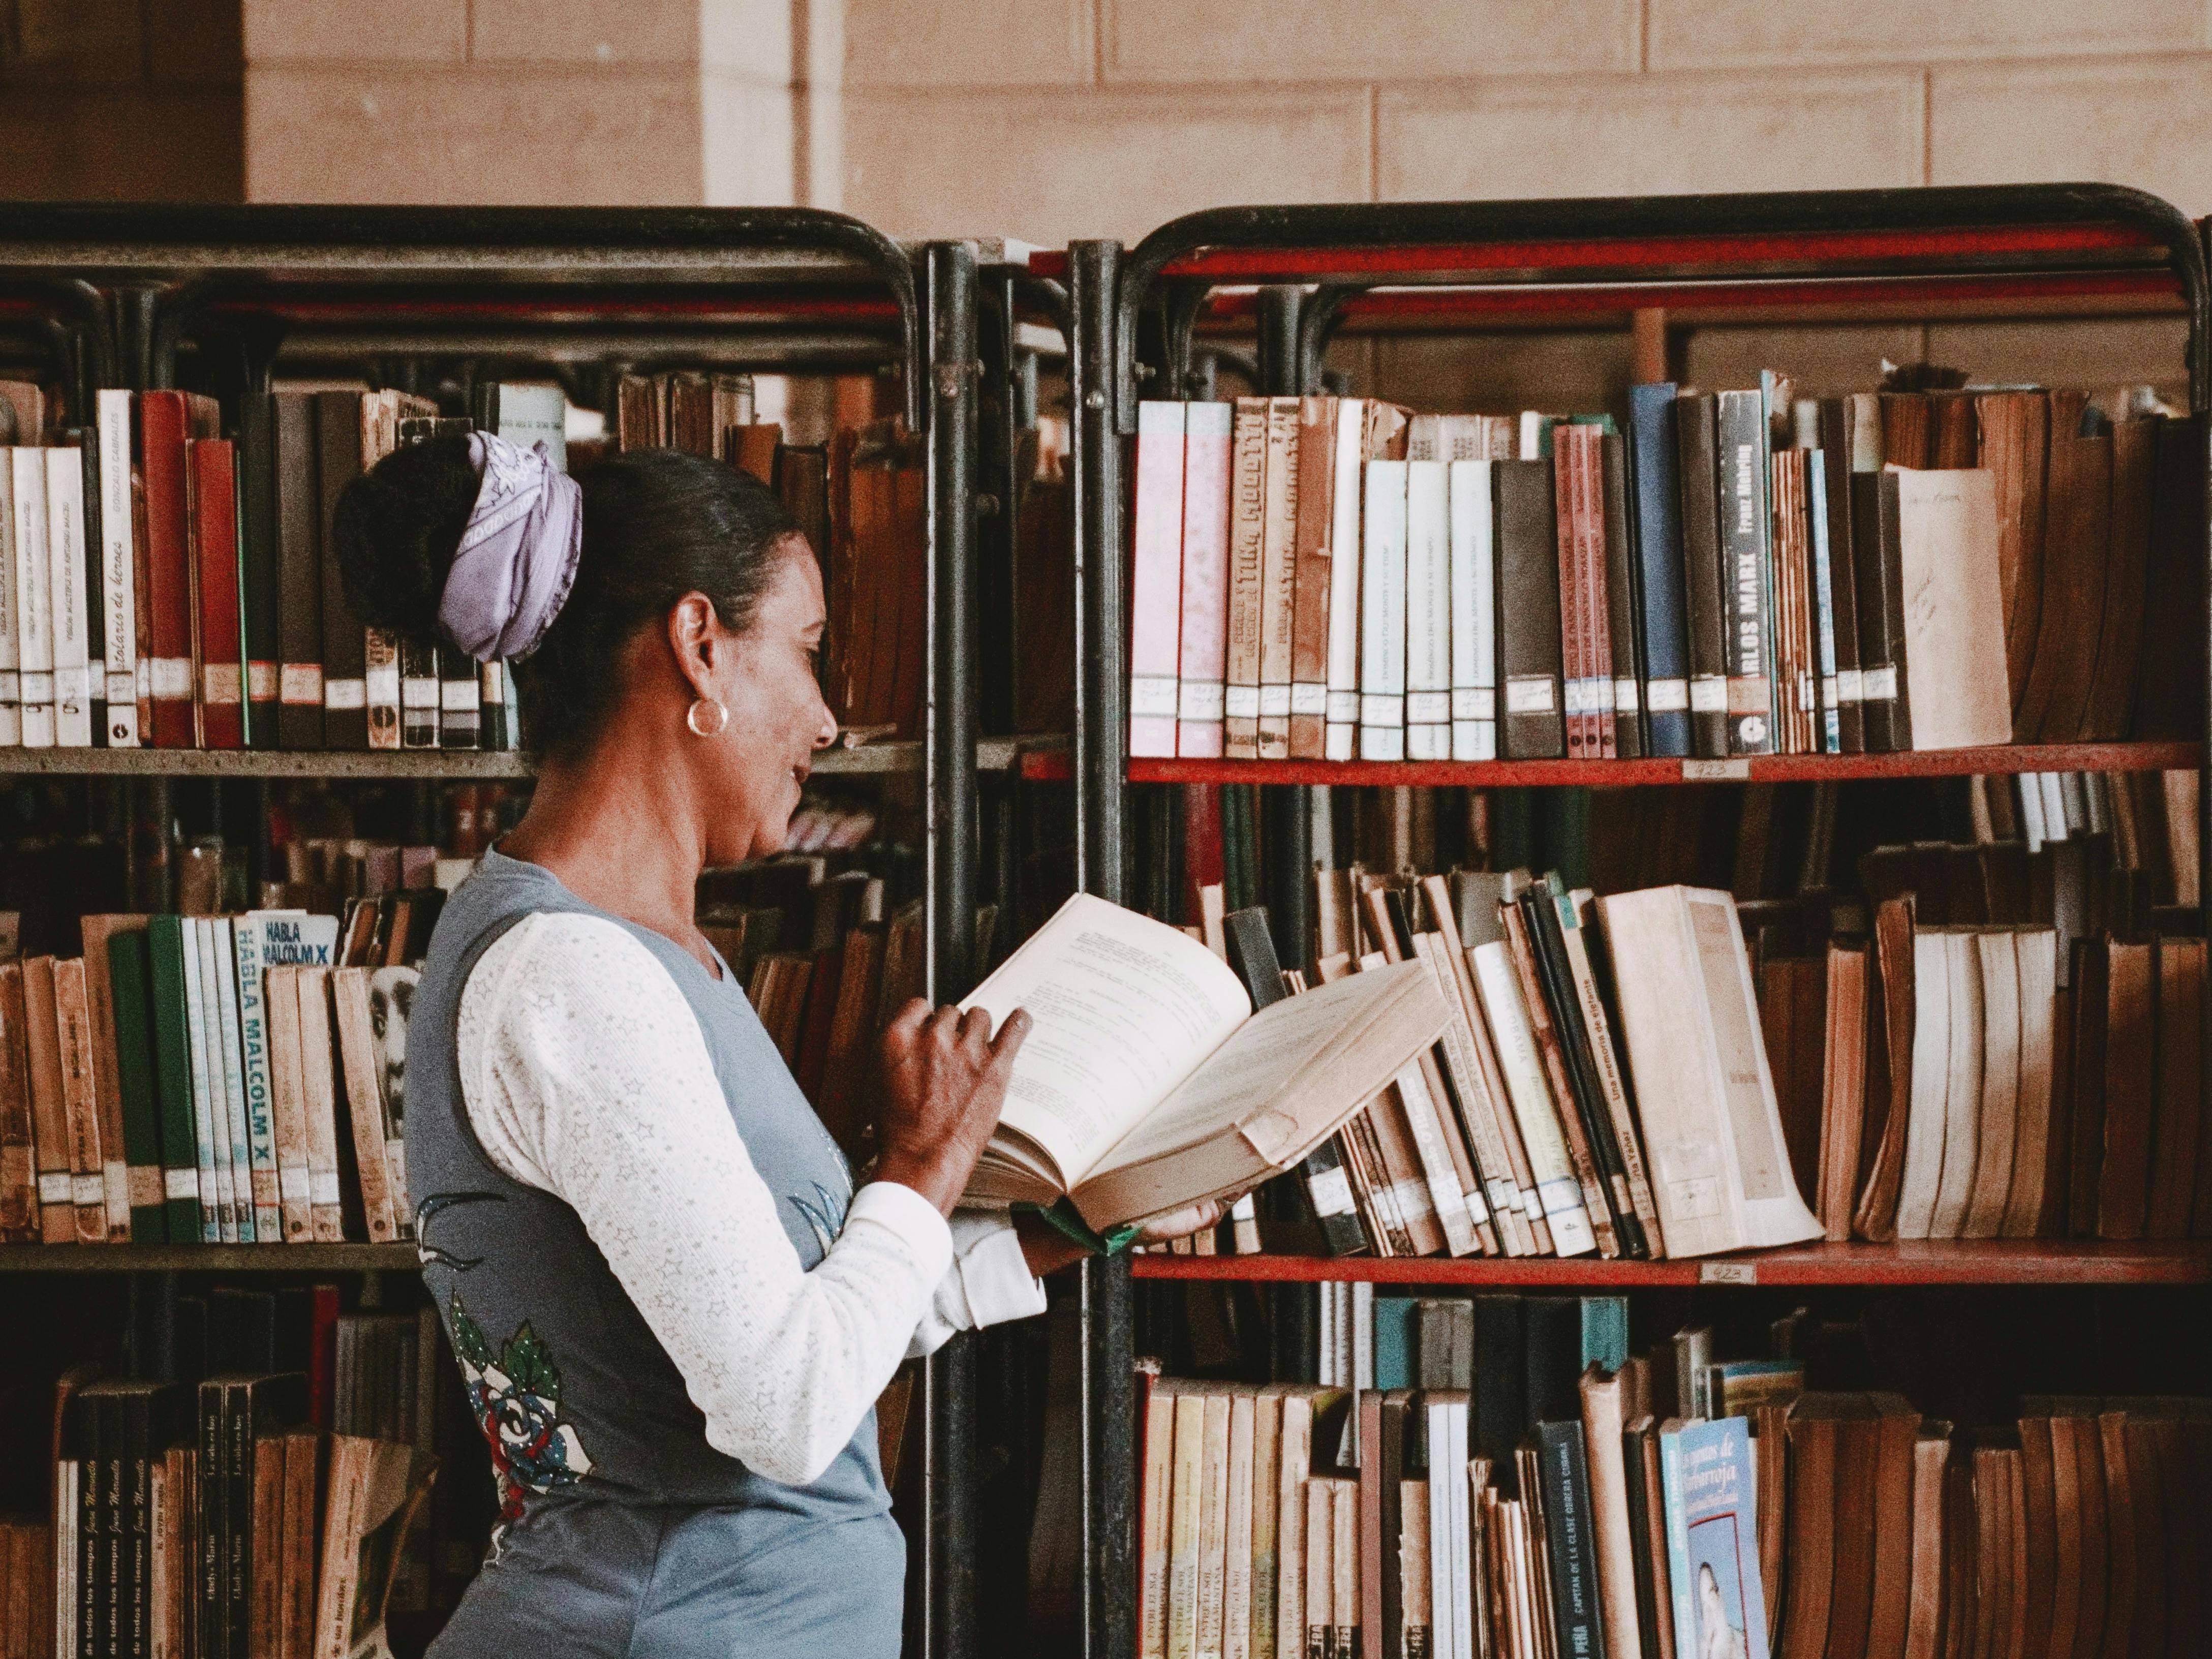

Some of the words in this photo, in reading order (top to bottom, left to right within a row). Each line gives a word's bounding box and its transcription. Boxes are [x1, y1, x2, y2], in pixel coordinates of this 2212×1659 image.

[110, 412, 120, 462] CABRALES
[112, 466, 121, 512] GONZALO
[1241, 417, 1262, 521] MODOTTI
[1736, 444, 1752, 496] Mehring
[1738, 499, 1752, 534] Franz
[64, 566, 72, 576] DE
[1236, 532, 1259, 584] TINA
[108, 592, 124, 608] de
[1739, 553, 1758, 613] MARX
[108, 613, 126, 671] stolario
[1740, 622, 1759, 679] ARLOS
[266, 921, 301, 942] HABLA
[239, 929, 258, 1009] HABLA
[262, 944, 313, 965] MALCOLM
[316, 944, 328, 965] X
[1581, 978, 1599, 1019] elefante
[1507, 1014, 1528, 1064] OBAMA
[1592, 1020, 1602, 1033] de
[246, 1019, 267, 1136] MALCOLM
[1596, 1035, 1614, 1079] memoria
[1609, 1080, 1620, 1101] Una
[254, 1143, 268, 1160] X
[1559, 1442, 1571, 1477] CUBANA
[85, 1459, 96, 1506] Marinello
[109, 1459, 119, 1506] Marinello
[133, 1459, 144, 1506] Marinello
[1562, 1479, 1574, 1514] OBRERA
[1565, 1516, 1577, 1545] CLASE
[86, 1540, 95, 1584] tiempos
[110, 1540, 118, 1584] tiempos
[134, 1540, 143, 1584] tiempos
[1569, 1547, 1578, 1559] LA
[1570, 1562, 1580, 1574] DE
[134, 1587, 142, 1604] los
[134, 1607, 142, 1639] todos
[85, 1642, 93, 1656] de
[109, 1642, 117, 1656] de
[134, 1642, 142, 1656] de
